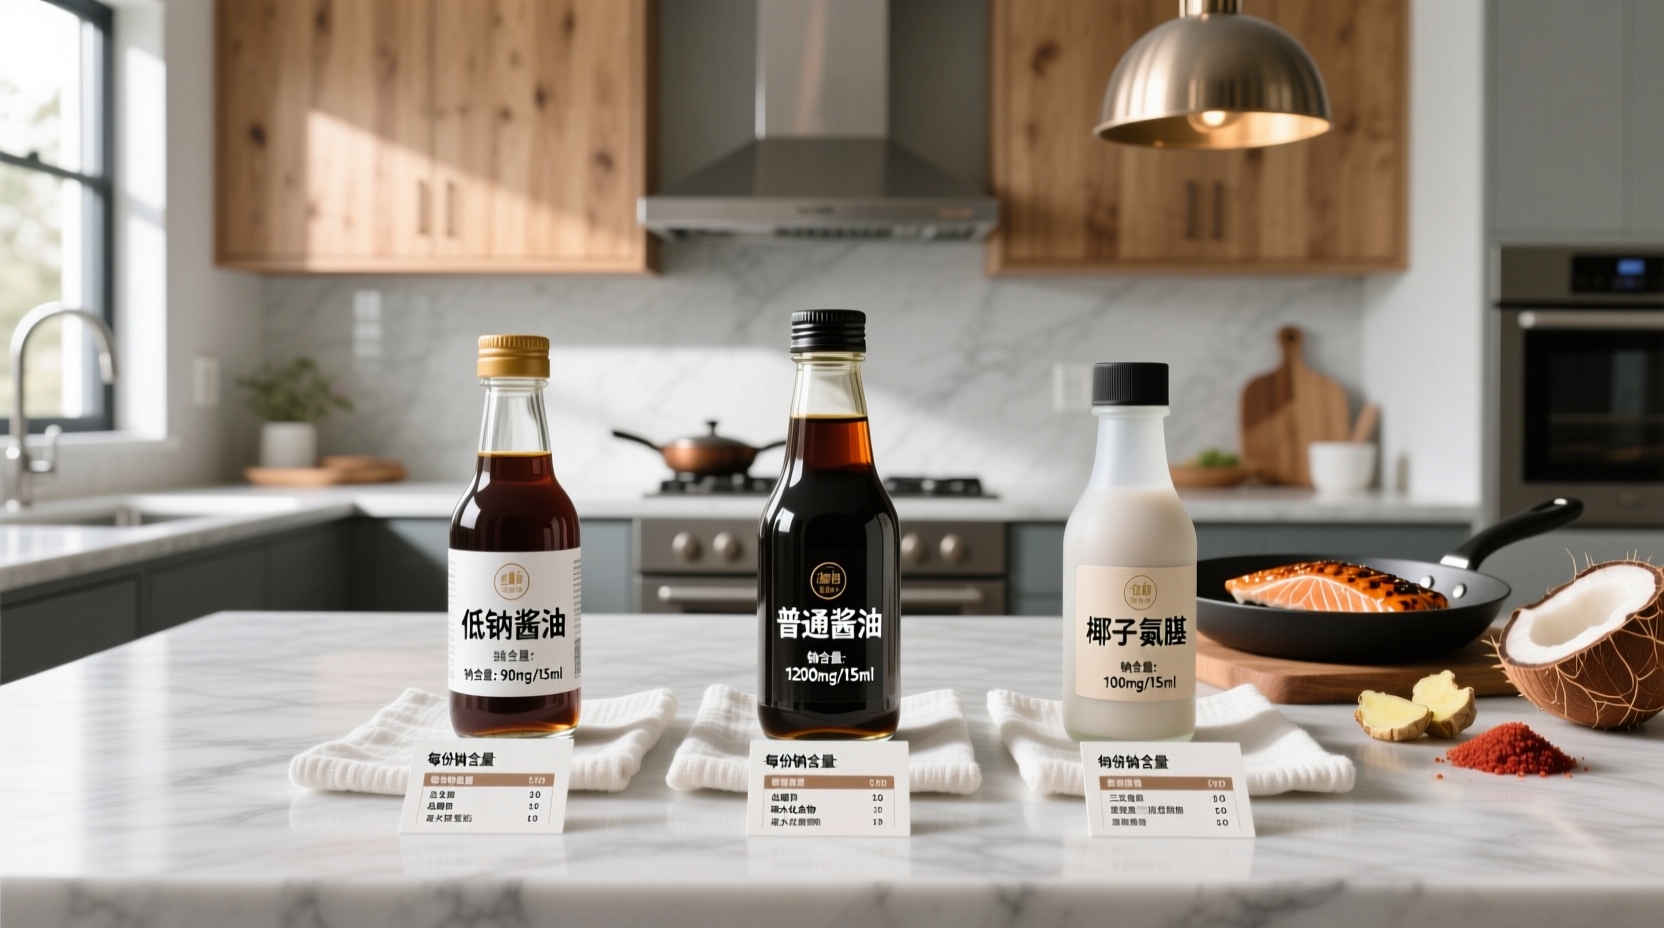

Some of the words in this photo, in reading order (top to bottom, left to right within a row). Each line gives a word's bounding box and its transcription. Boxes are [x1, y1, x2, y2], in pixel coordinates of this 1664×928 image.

[462, 607, 566, 640] 低钠酱油
[776, 606, 883, 640] 普通酱油
[785, 666, 875, 686] 1200mg/15ml
[1103, 675, 1177, 693] 100mg/15ml
